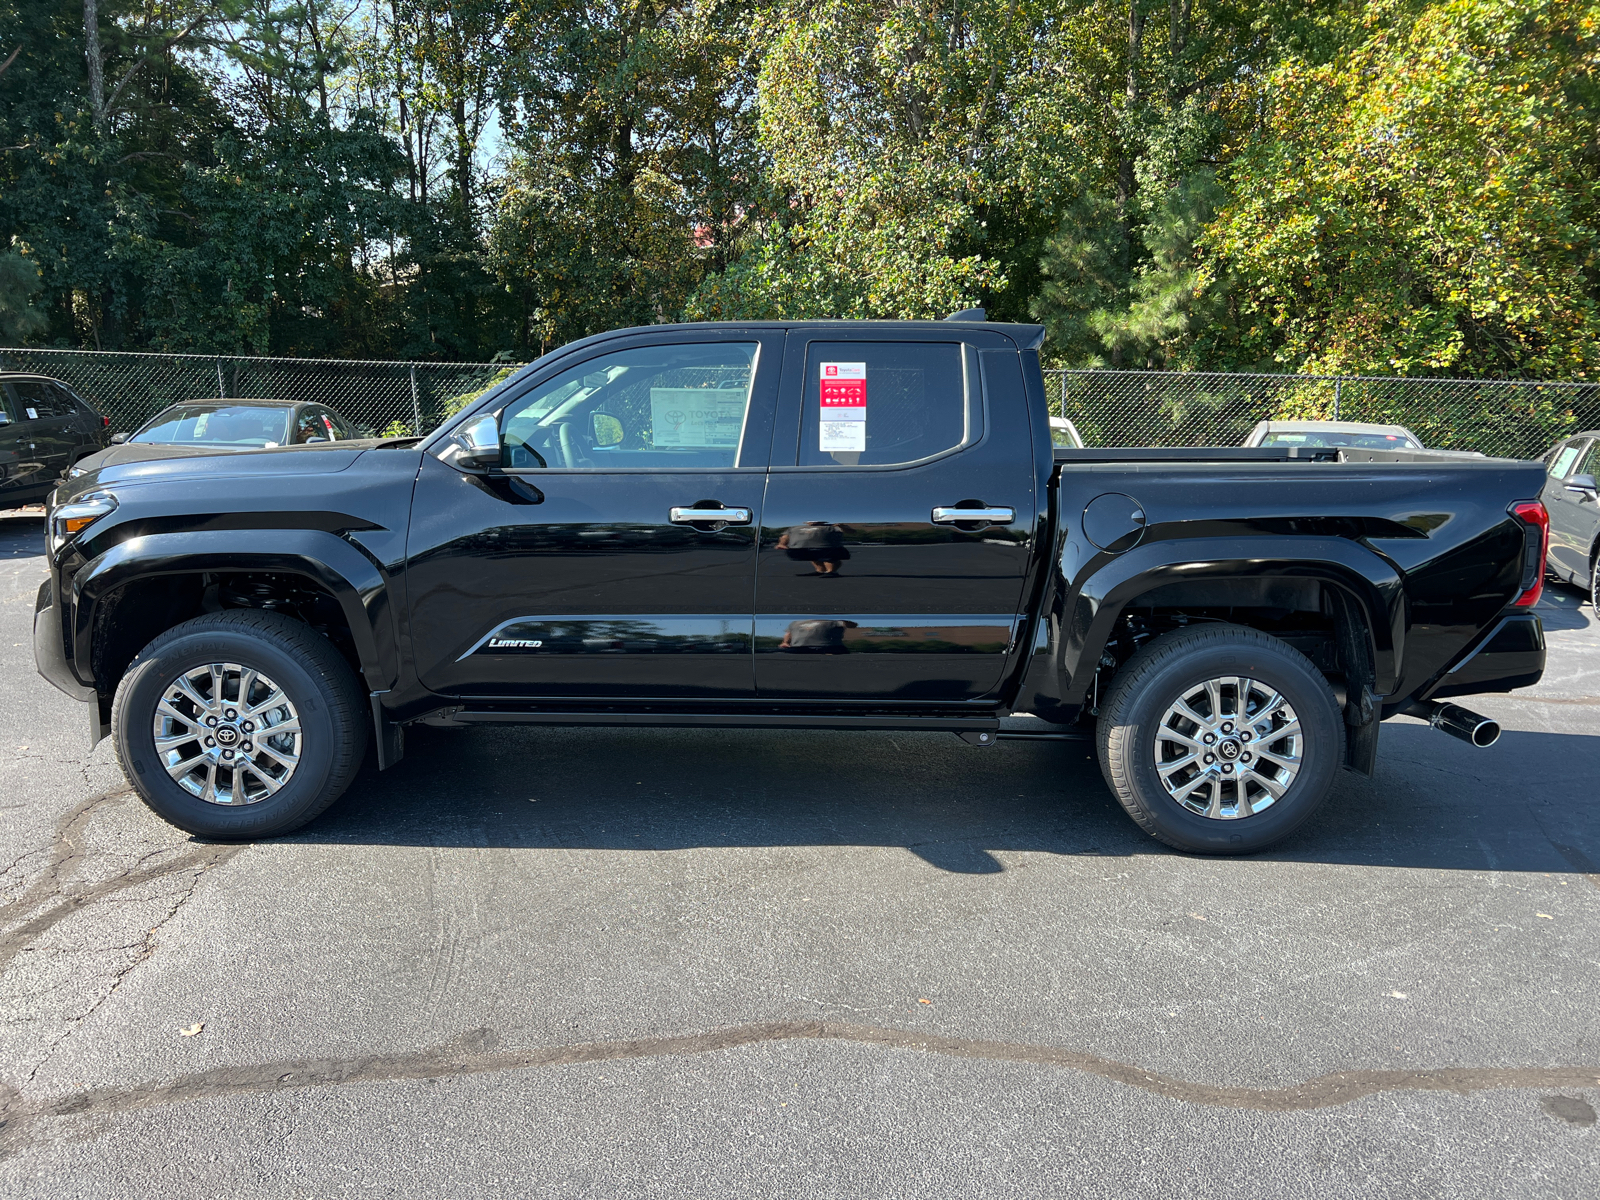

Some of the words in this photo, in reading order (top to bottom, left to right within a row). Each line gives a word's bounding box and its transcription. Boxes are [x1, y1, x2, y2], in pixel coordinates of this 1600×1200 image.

[688, 410, 732, 419] TOYOTA
[488, 638, 543, 648] LIMITED
[148, 641, 230, 678] GENERAL
